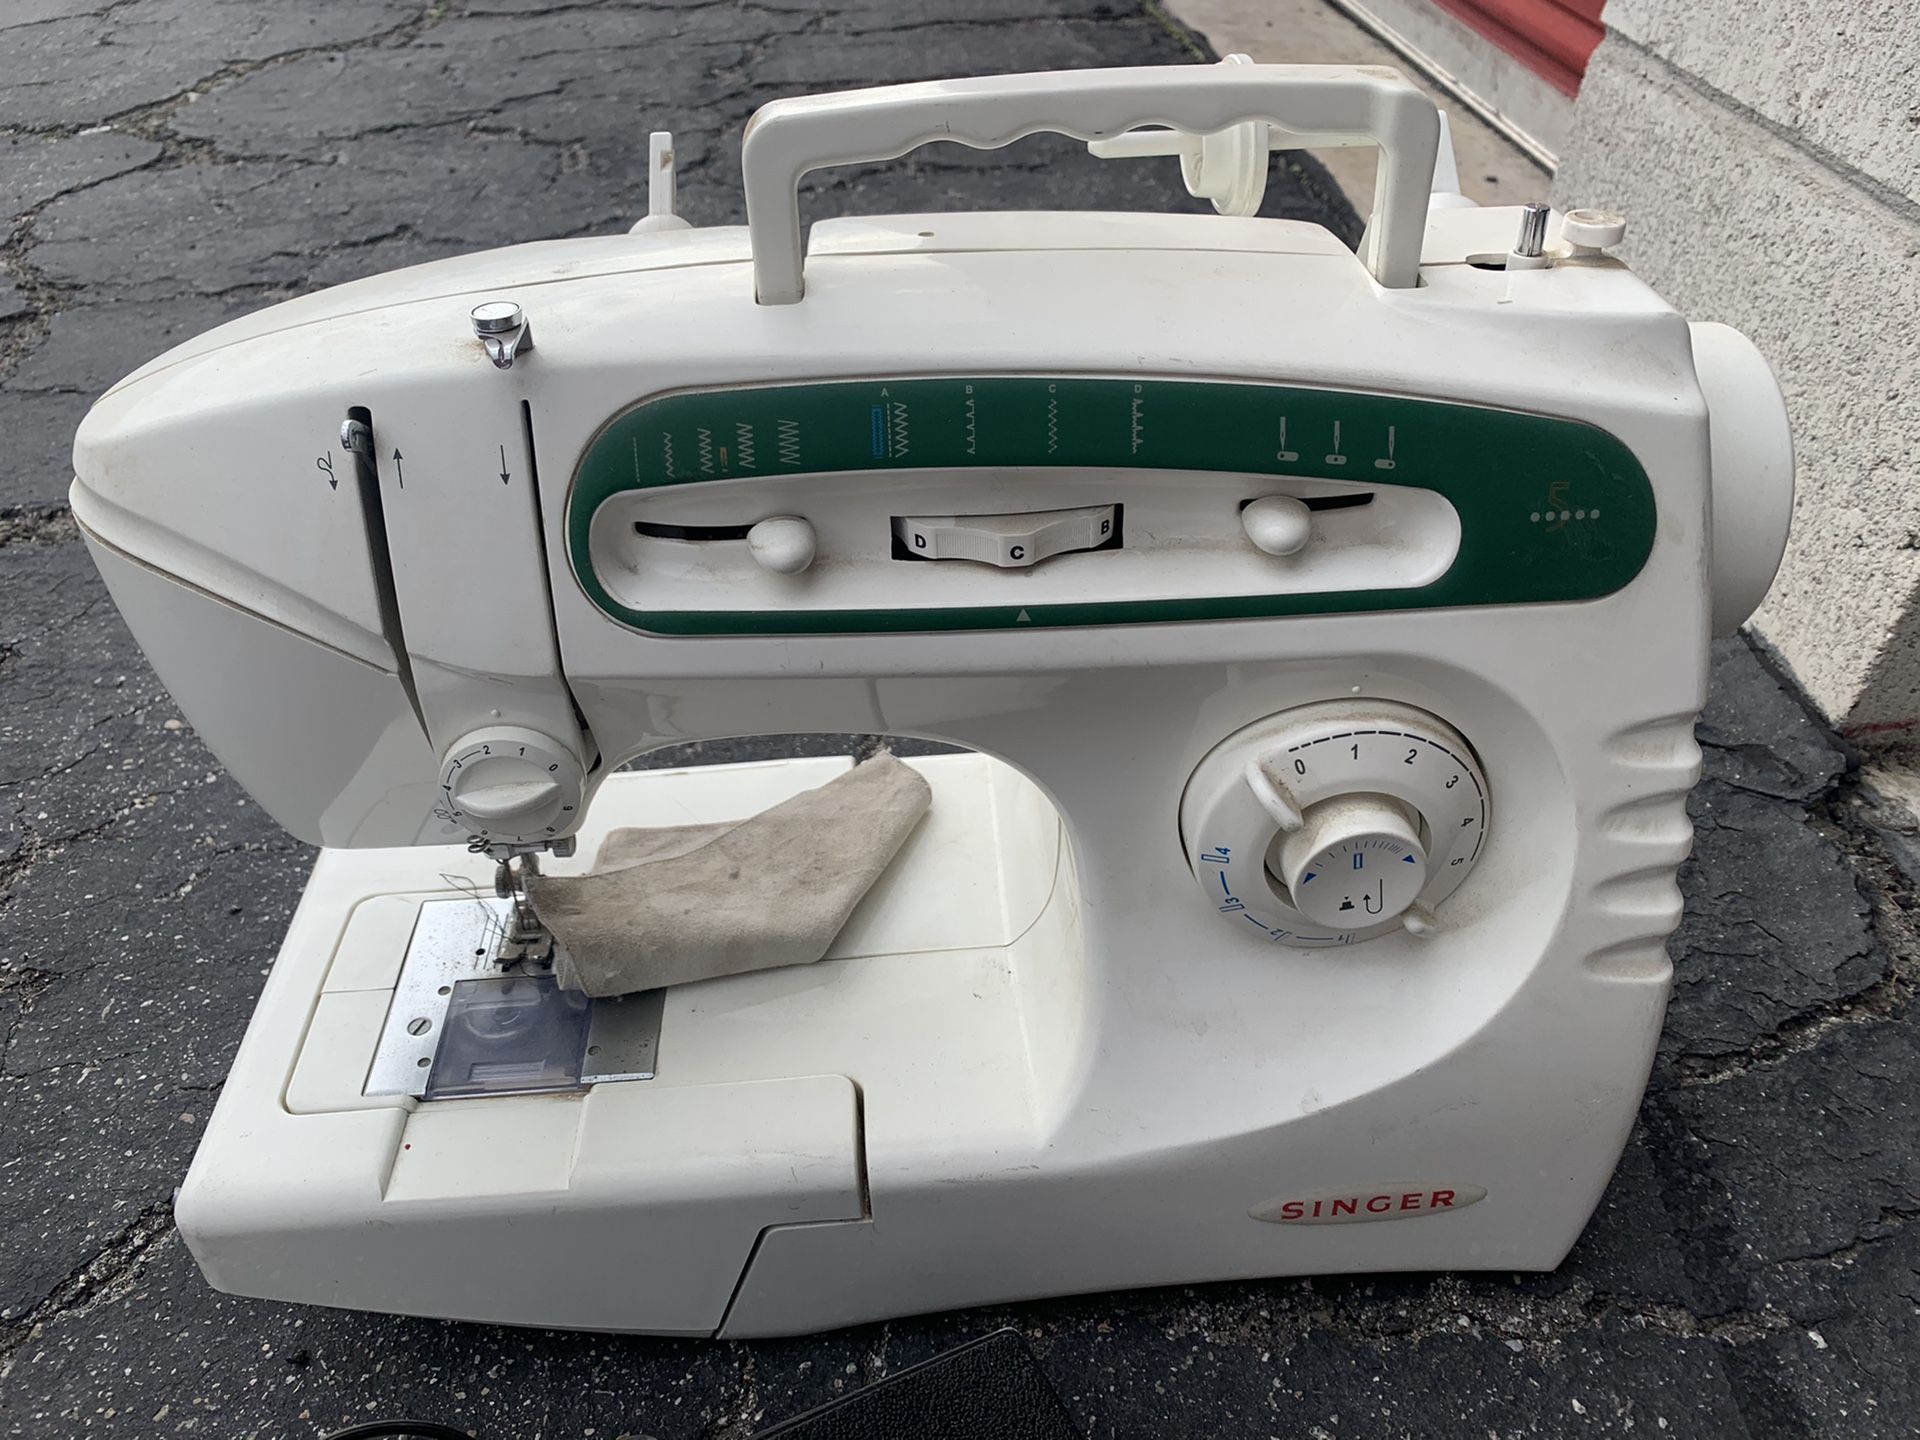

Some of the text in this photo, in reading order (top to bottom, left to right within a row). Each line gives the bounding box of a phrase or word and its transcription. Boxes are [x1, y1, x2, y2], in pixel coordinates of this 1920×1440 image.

[881, 387, 889, 397] A
[966, 385, 973, 394] B
[1048, 384, 1057, 394] C
[1134, 384, 1142, 394] D
[1101, 519, 1110, 536] B
[914, 533, 926, 549] D
[1010, 544, 1025, 560] C
[483, 745, 559, 772] 2 1 0
[453, 760, 462, 769] 3
[442, 784, 452, 793] 4
[1295, 744, 1474, 866] 0 1 2 3 4 5
[1215, 847, 1231, 856] 4
[1281, 1190, 1456, 1220] SINGER
